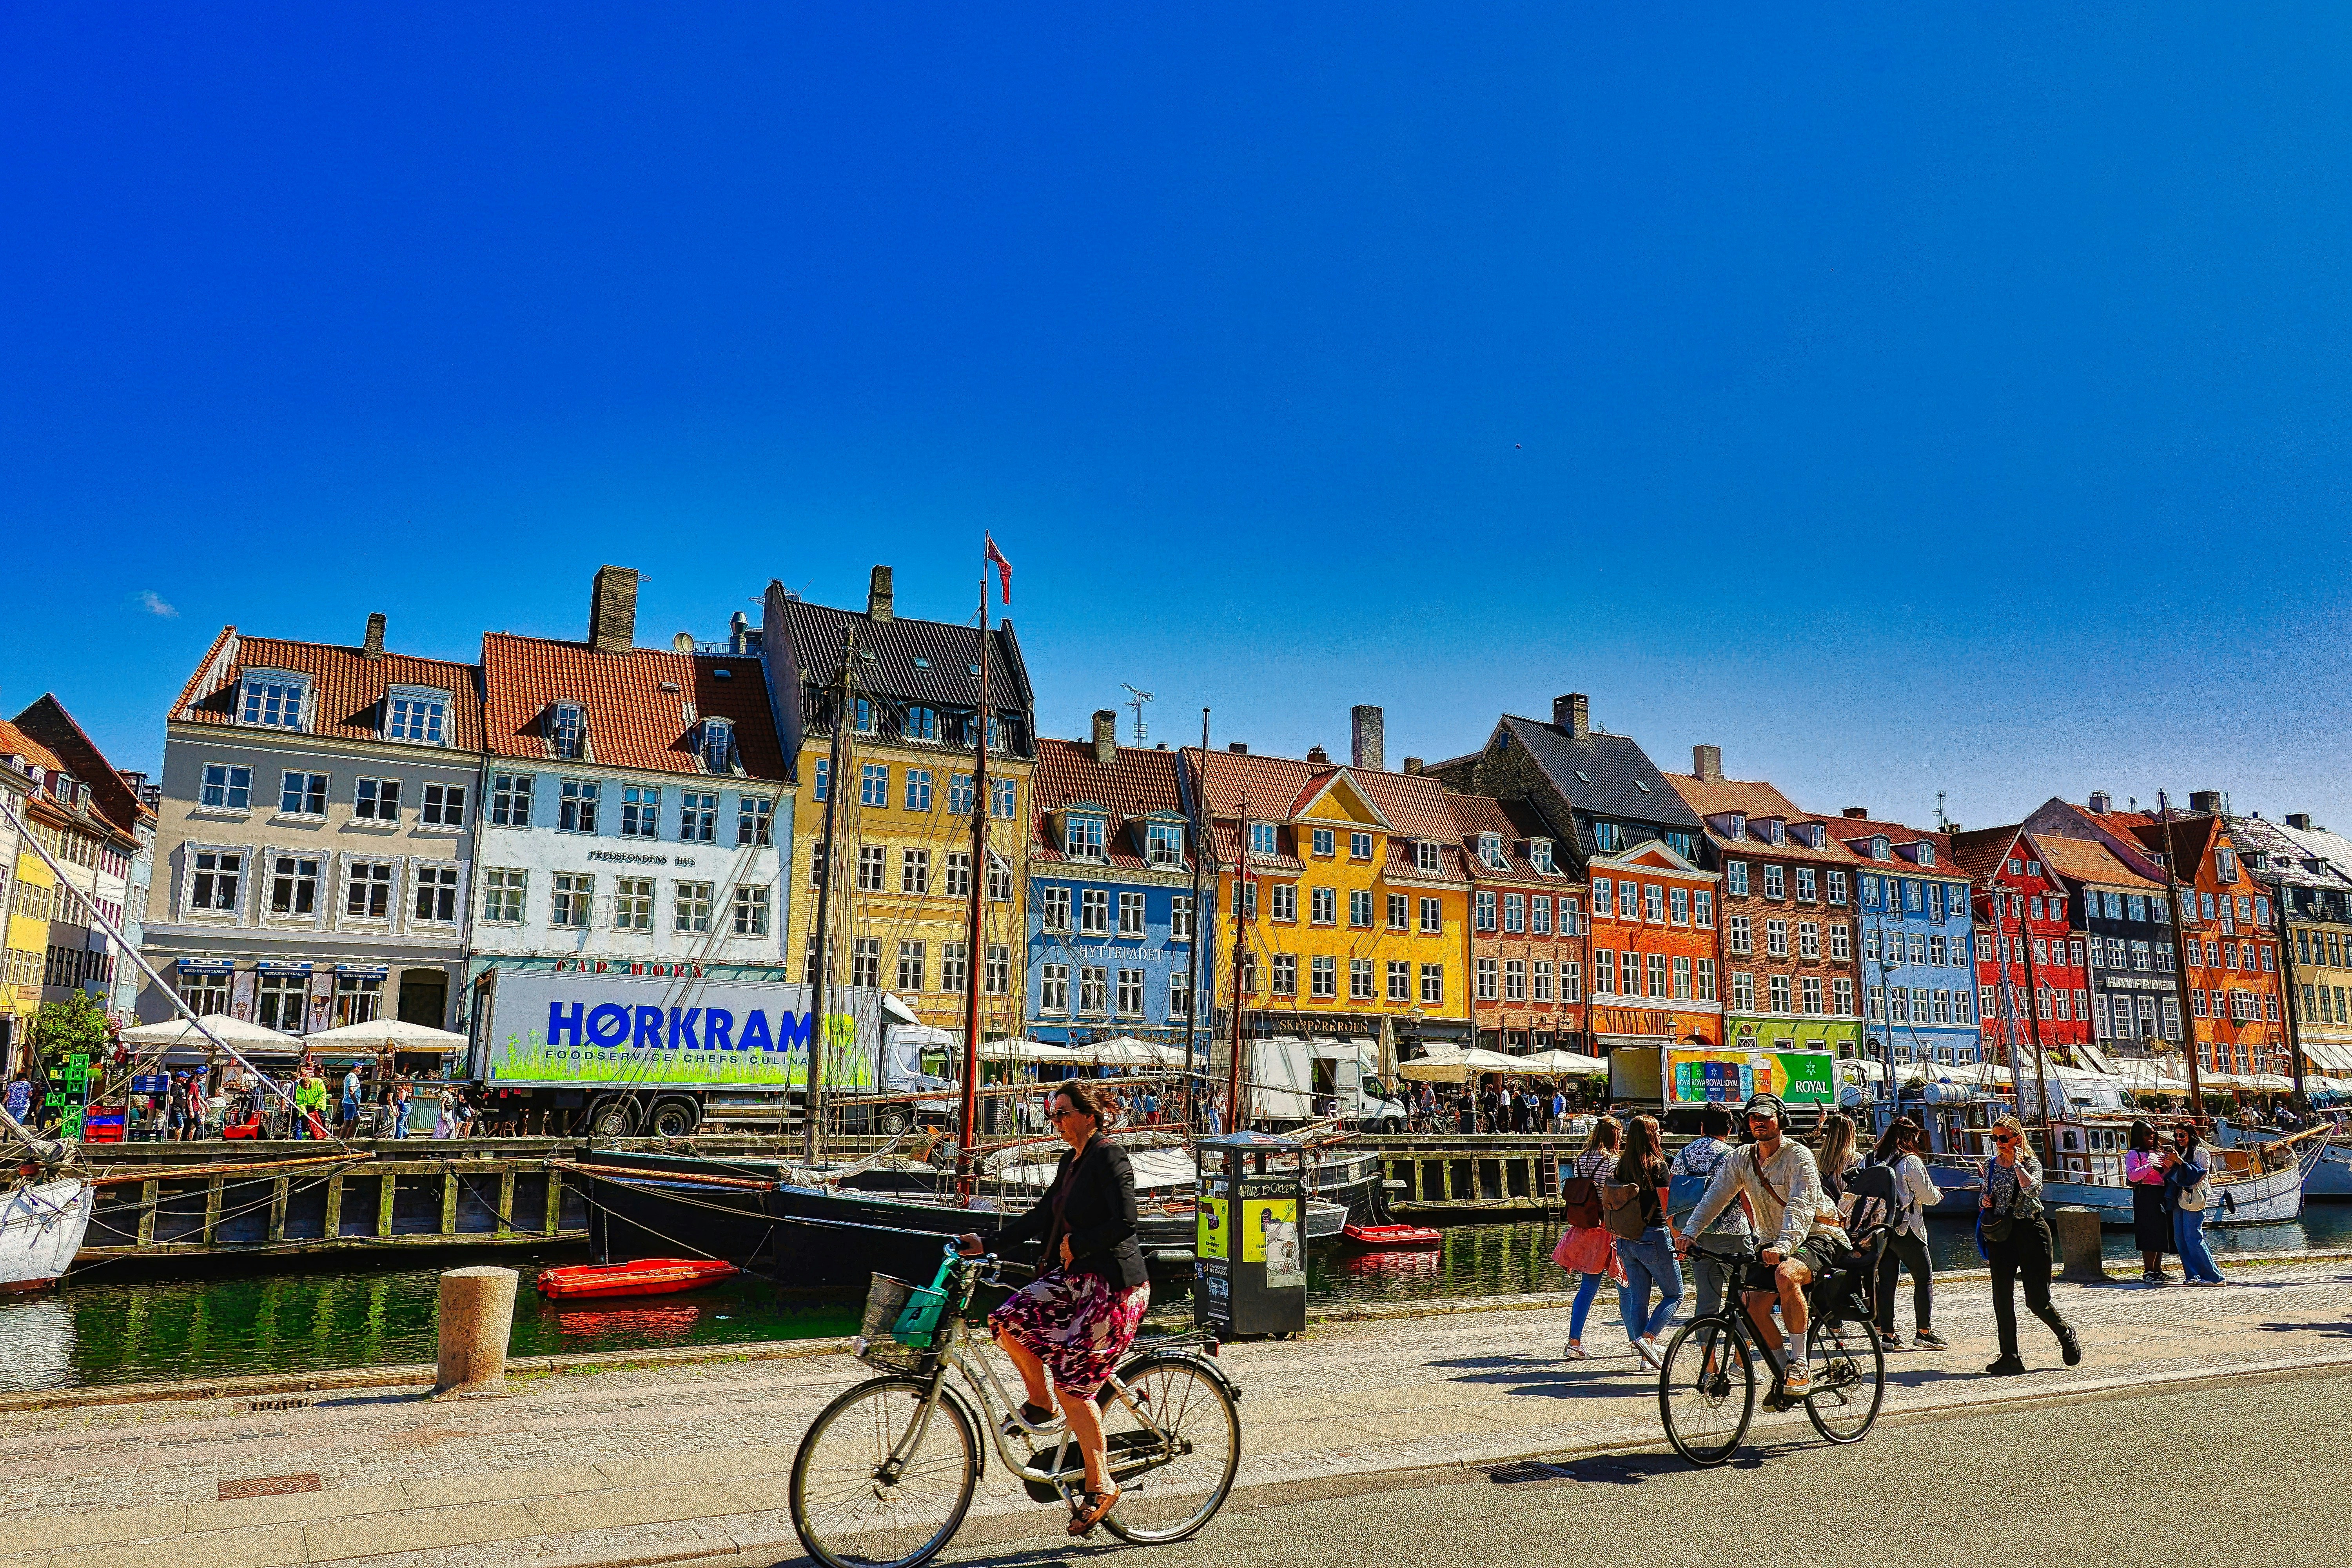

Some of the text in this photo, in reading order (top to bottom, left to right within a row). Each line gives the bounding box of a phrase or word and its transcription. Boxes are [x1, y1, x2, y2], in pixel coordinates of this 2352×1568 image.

[589, 850, 696, 867] FREDSFONDENS HUS
[1079, 944, 1163, 962] HYTTEFADET
[555, 960, 703, 978] CAP HORN
[2106, 976, 2177, 991] HAVFRUEN
[547, 1001, 811, 1052] HØRKRAM
[1279, 1020, 1368, 1033] SKIPPERKROEN
[545, 1050, 672, 1062] FOODSERVICE
[683, 1054, 737, 1063] CHEFS
[1795, 1080, 1829, 1093] ROYAL
